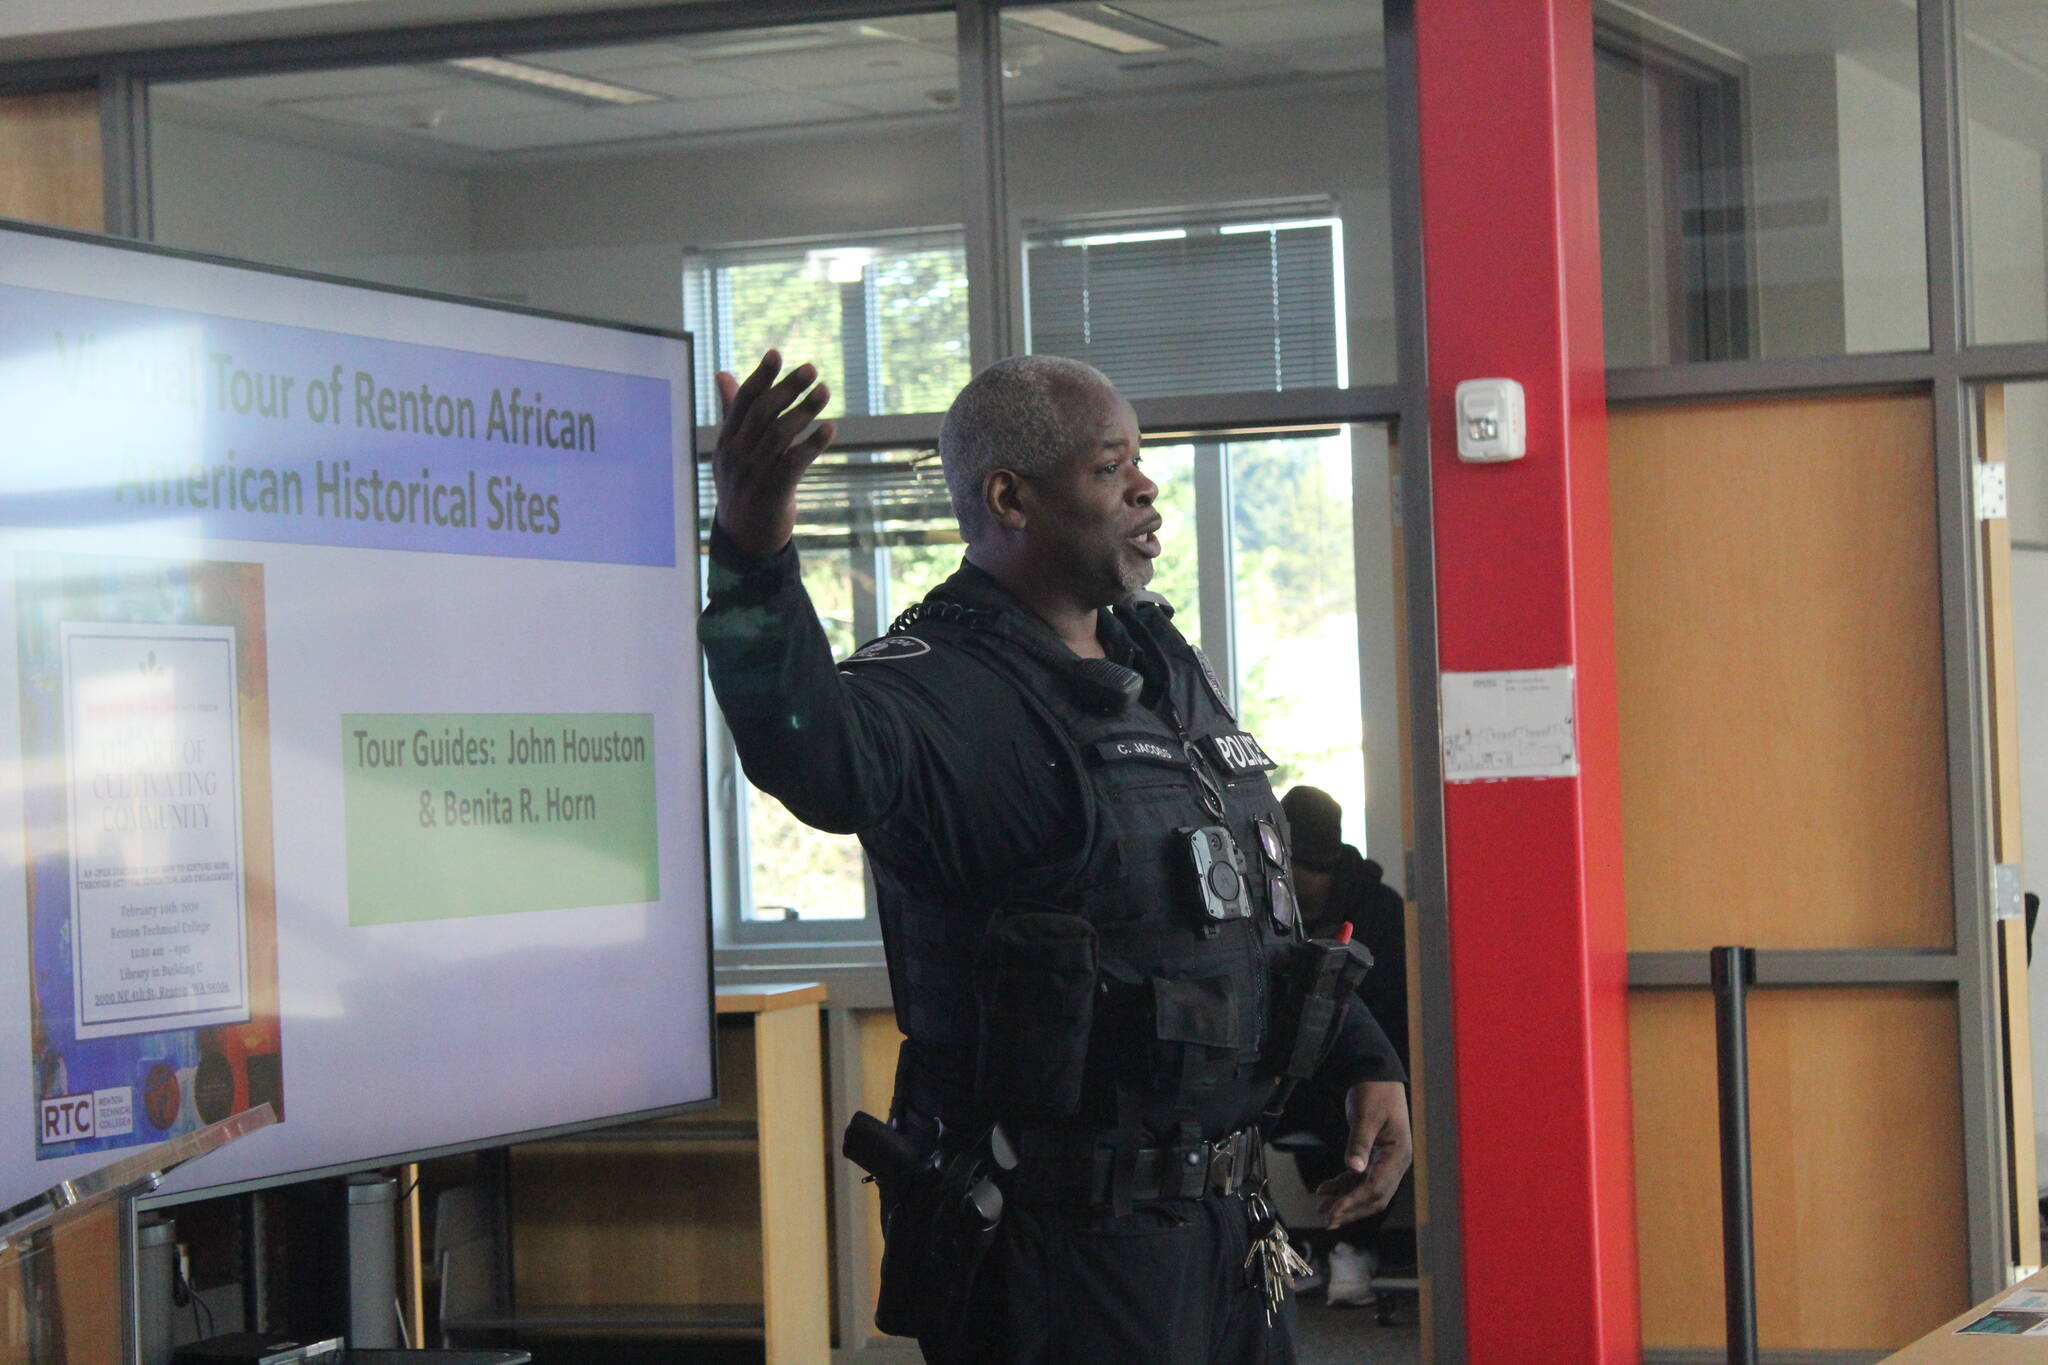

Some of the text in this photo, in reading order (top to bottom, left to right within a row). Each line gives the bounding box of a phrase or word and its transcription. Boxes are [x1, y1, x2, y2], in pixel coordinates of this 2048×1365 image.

[208, 352, 295, 419] Tour
[307, 364, 343, 426] of
[354, 371, 475, 441] Renton
[485, 387, 596, 453] African
[115, 449, 561, 536] American Historical Sites
[353, 727, 646, 768] Tour Guides: John Houston
[1117, 743, 1132, 755] C.
[1214, 735, 1270, 769] POLICE
[93, 770, 217, 800] CULTIVATING
[418, 787, 597, 828] & Benita R. Horn
[121, 903, 157, 918] February
[143, 921, 180, 937] Technical
[182, 920, 211, 936] College
[44, 1101, 90, 1138] RTC
